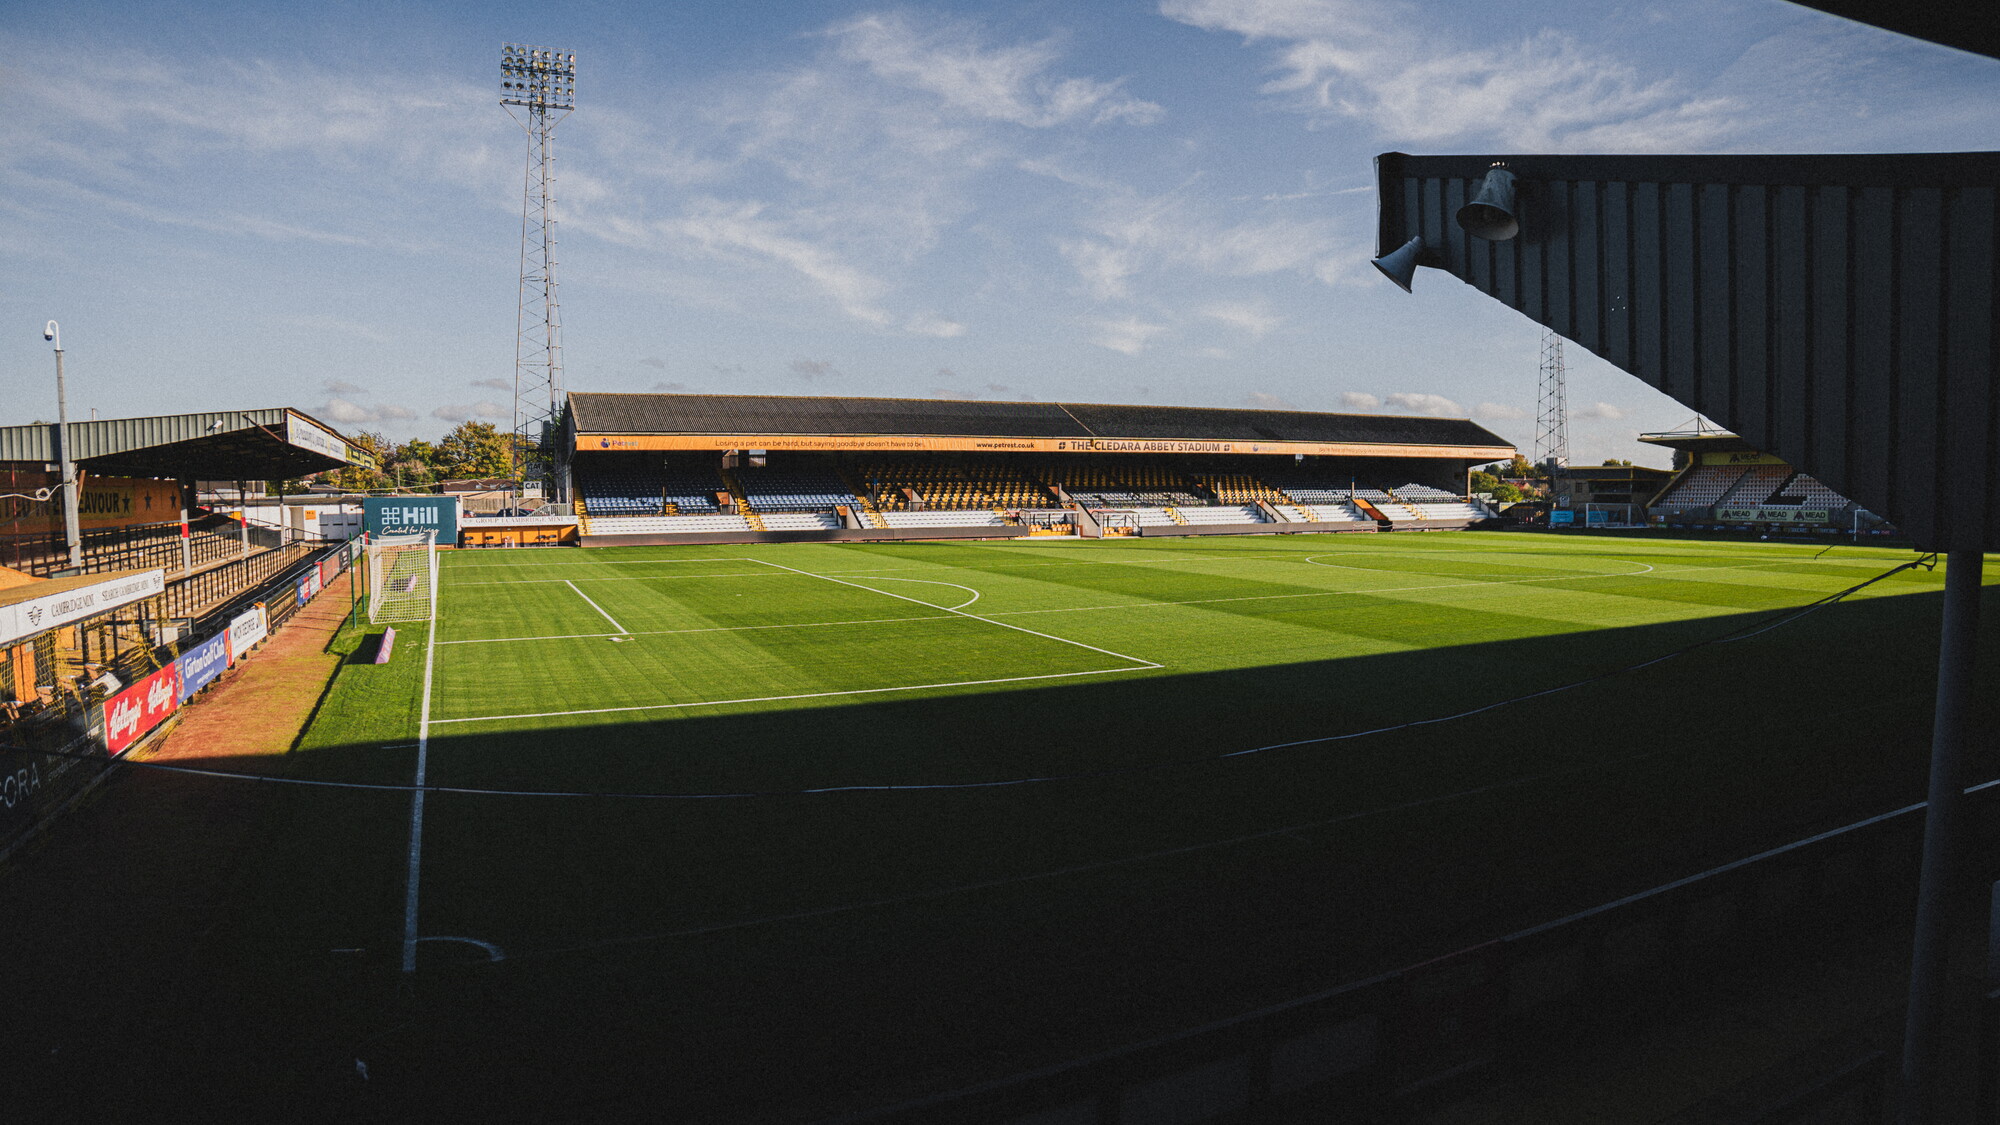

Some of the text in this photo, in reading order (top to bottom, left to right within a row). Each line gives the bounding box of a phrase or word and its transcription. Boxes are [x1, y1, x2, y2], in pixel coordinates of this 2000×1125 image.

[715, 440, 739, 448] Losing
[746, 440, 757, 449] pet
[783, 440, 799, 448] hard,
[814, 441, 834, 449] saying
[836, 440, 865, 449] goodbye
[1071, 441, 1220, 452] THE CLEDARA ABBEY STADIUM
[525, 482, 540, 490] CAT
[403, 507, 438, 524] Hill
[1732, 510, 1751, 518] MEAD
[1805, 511, 1826, 519] MEAD
[381, 525, 408, 535] Created
[409, 526, 418, 535] for
[51, 593, 95, 617] CAMBRIDGE MINI
[185, 656, 204, 679] Girton
[202, 642, 214, 668] Golf
[213, 637, 225, 660] Club
[147, 676, 175, 715] Kellogg's
[110, 696, 143, 741] Kellogg's
[0, 761, 41, 809] ORA
